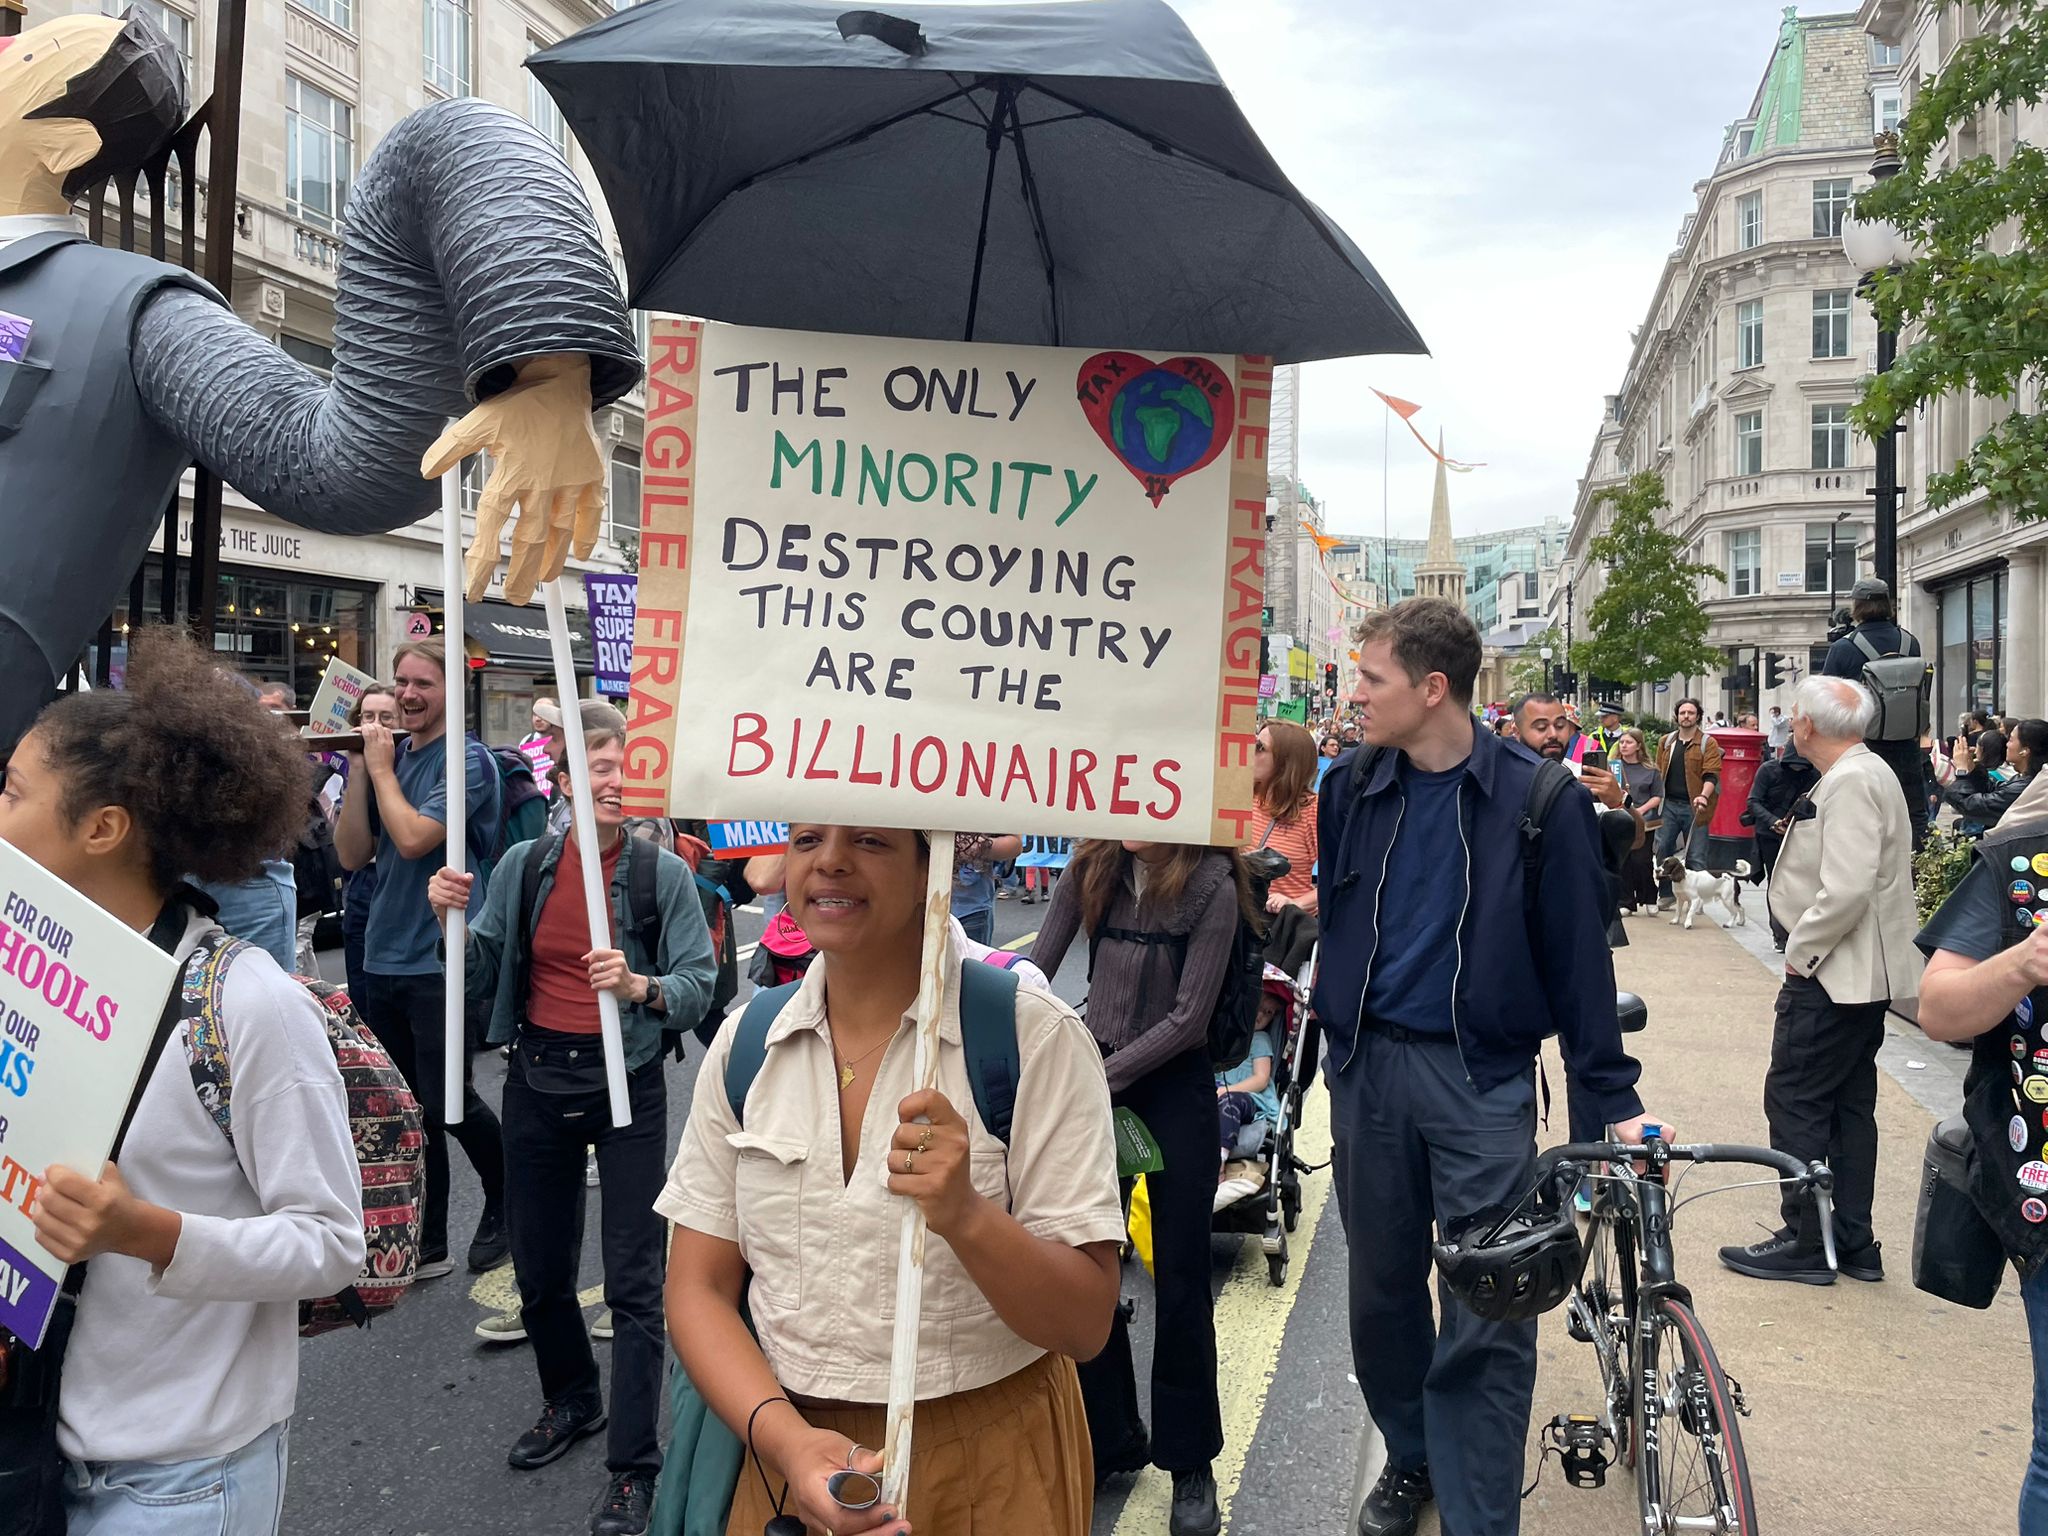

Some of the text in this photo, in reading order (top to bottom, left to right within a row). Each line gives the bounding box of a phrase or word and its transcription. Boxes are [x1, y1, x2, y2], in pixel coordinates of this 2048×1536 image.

[714, 362, 1037, 422] THE ONLY
[1077, 358, 1224, 404] TAX THE
[640, 320, 698, 570] RAGILE
[771, 431, 1098, 527] MINORITY
[1145, 475, 1170, 498] 1%
[230, 528, 257, 552] THE
[262, 534, 301, 559] JUICE
[722, 517, 1136, 601] DESTROYING
[591, 583, 637, 604] TAX
[600, 606, 633, 616] THE
[595, 617, 634, 640] SUPE
[739, 583, 1172, 669] THIS COUNTRY
[597, 641, 632, 673] RIC
[806, 646, 1062, 712] ARE THE
[728, 713, 1182, 821] BILLIONAIRES
[723, 820, 789, 848] MAKE
[4, 891, 73, 959] FOR OUR
[0, 920, 119, 1042] HOOLS
[5, 1009, 40, 1053] OUR
[0, 1258, 30, 1307] AY
